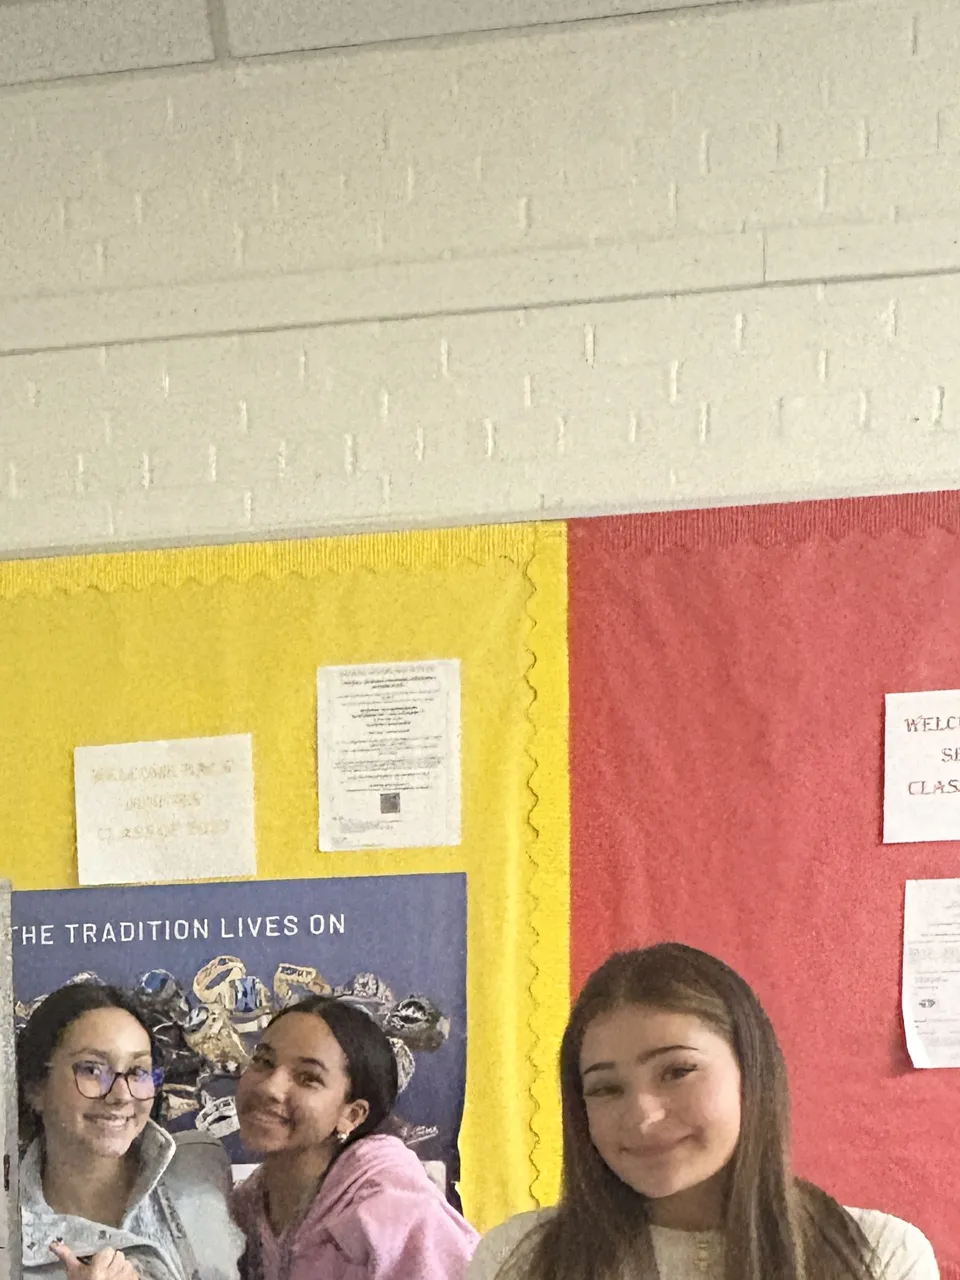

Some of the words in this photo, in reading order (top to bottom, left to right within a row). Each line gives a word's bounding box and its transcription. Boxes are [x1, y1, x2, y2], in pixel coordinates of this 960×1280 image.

[904, 715, 960, 733] WELC
[908, 779, 960, 796] CLAS
[64, 918, 209, 944] TRADITION
[220, 914, 299, 939] LIVES
[310, 913, 346, 935] ON
